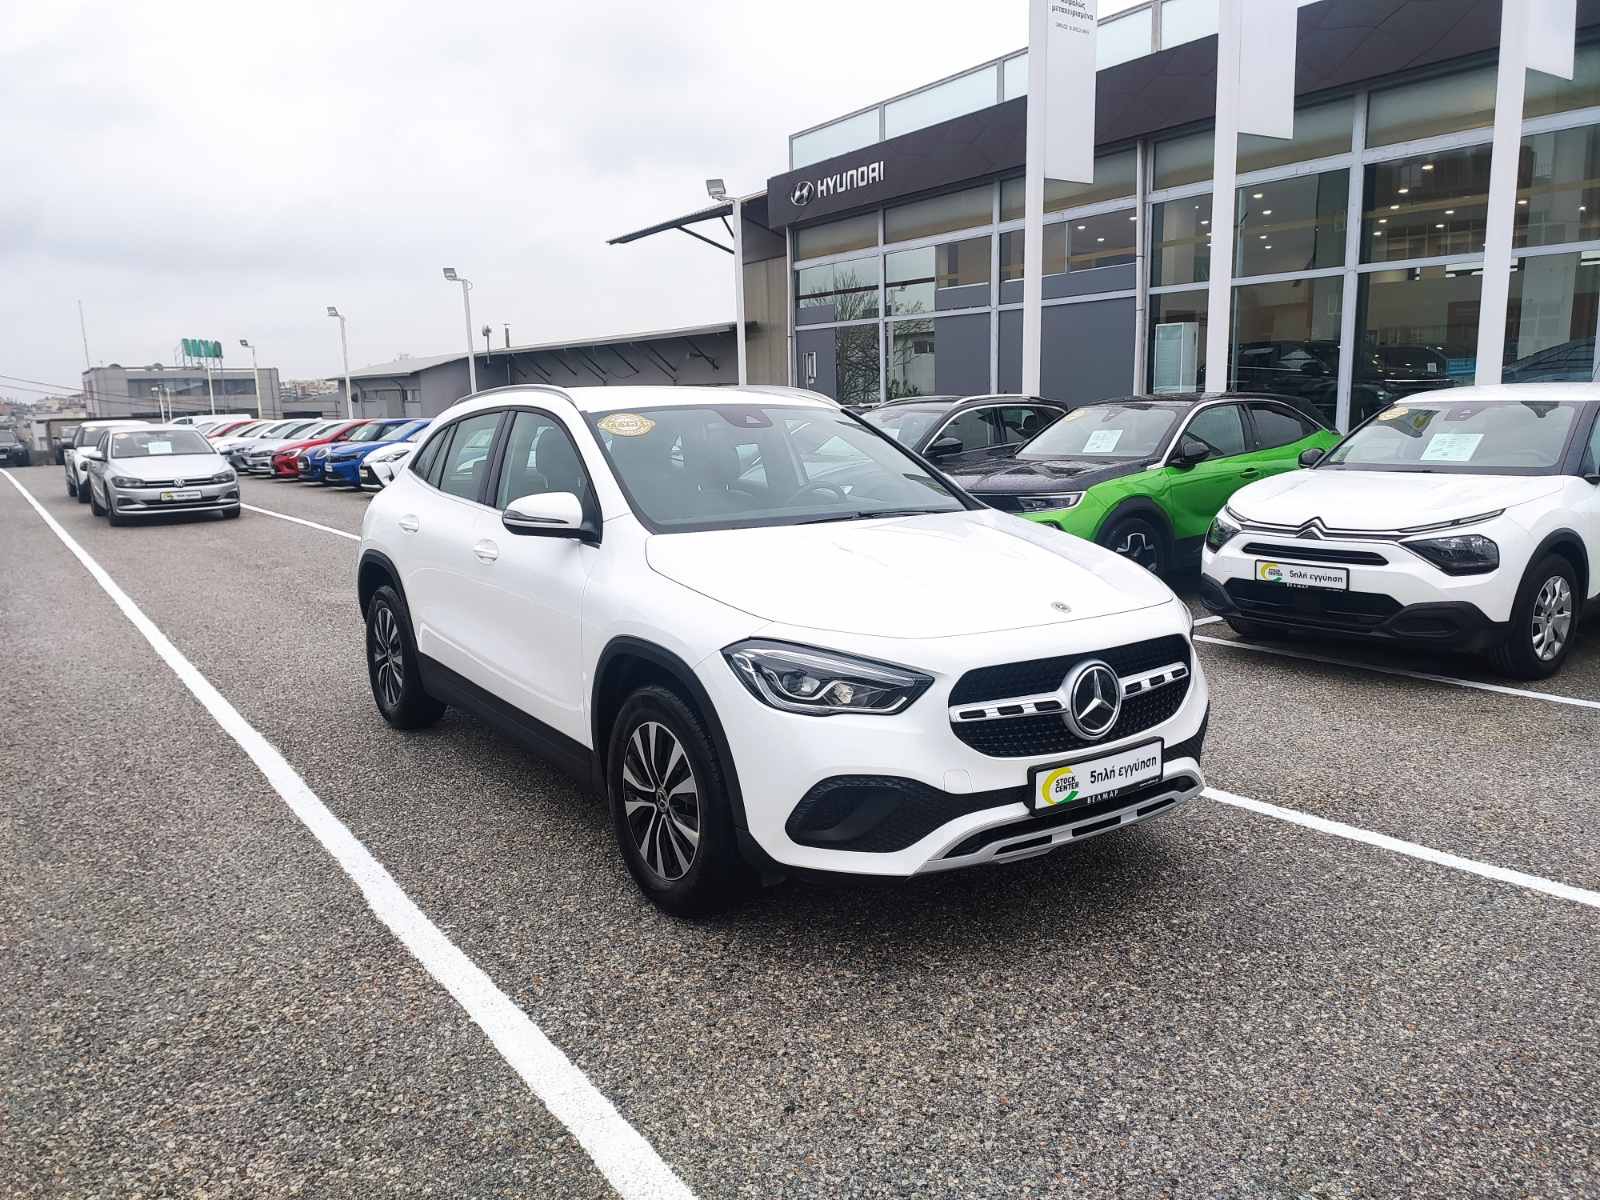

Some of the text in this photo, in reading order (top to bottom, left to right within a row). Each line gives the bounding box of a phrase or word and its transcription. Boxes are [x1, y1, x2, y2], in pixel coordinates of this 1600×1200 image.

[817, 160, 884, 198] HYUNDAI
[1090, 764, 1116, 784] 5πλή
[1118, 756, 1157, 777] εγγύηση
[1055, 775, 1076, 787] STOCK
[1055, 781, 1079, 793] CENTER
